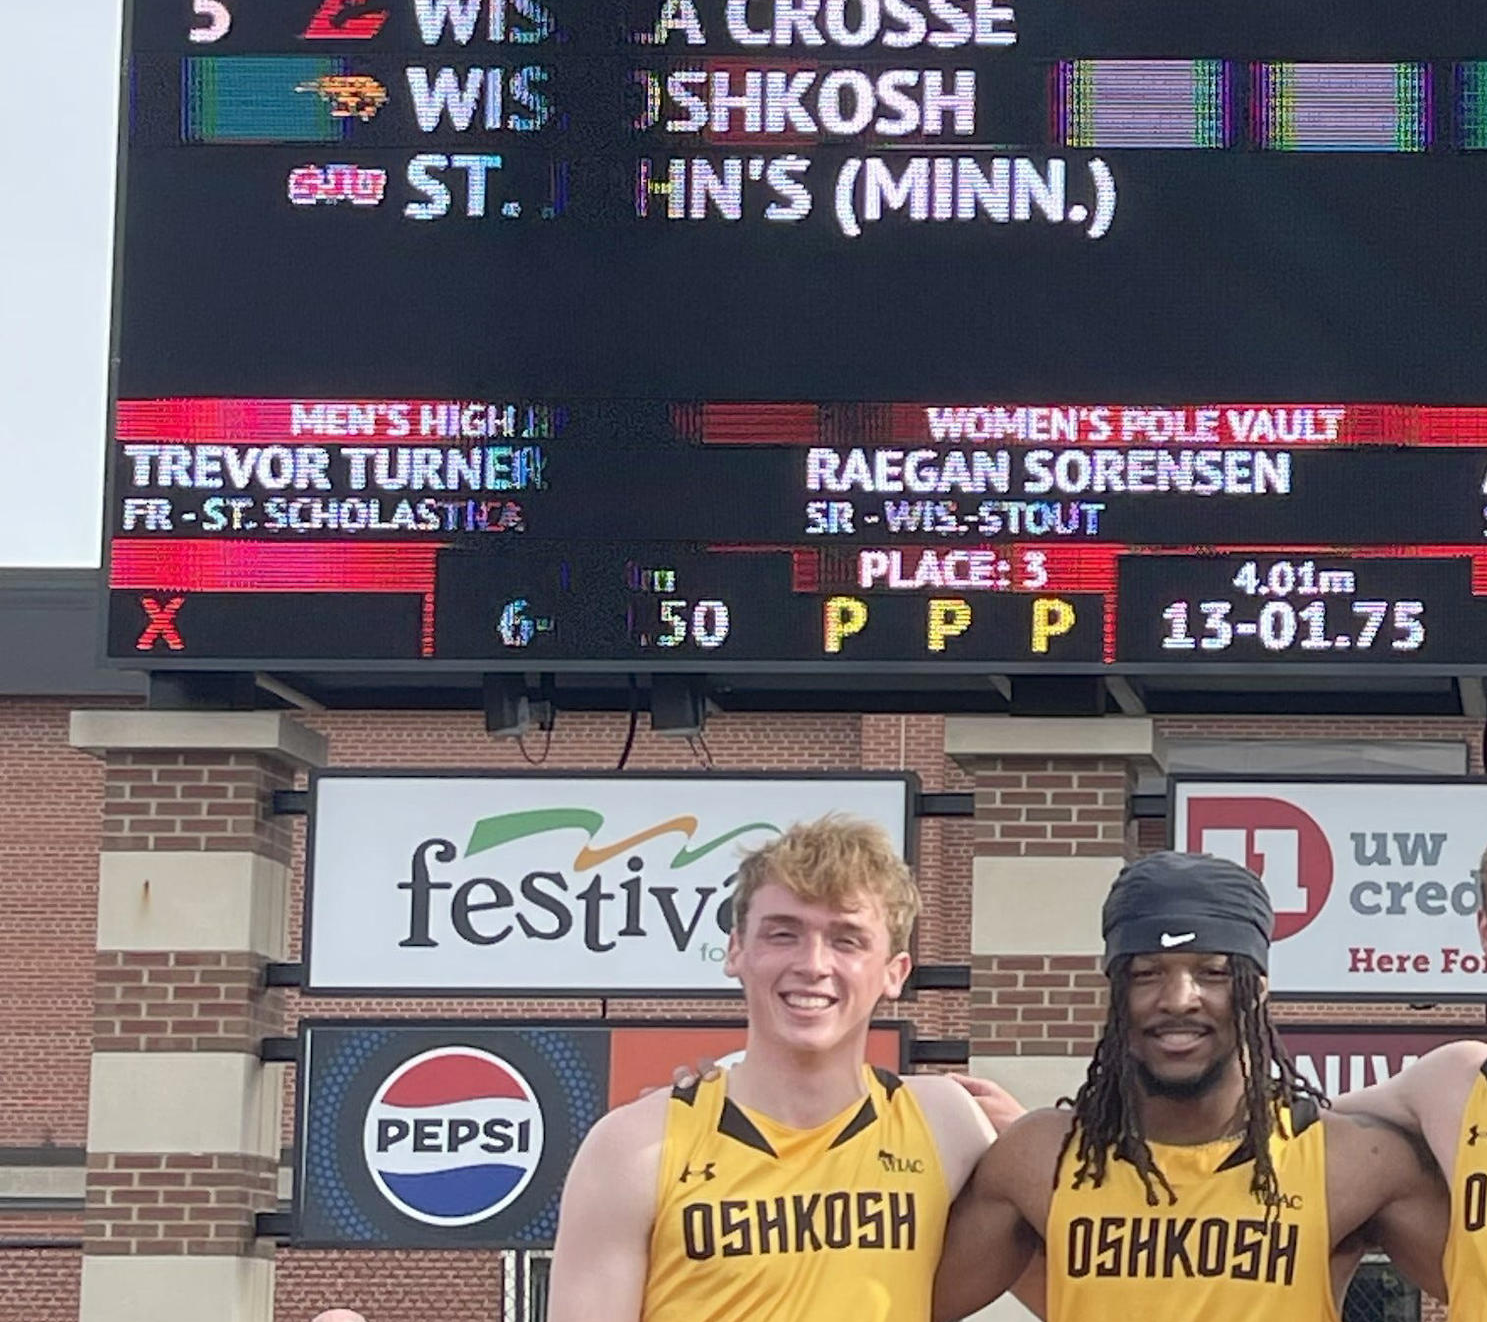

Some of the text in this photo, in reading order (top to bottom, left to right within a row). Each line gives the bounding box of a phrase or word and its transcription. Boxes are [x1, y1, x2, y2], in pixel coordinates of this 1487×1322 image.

[405, 153, 522, 220] ST.
[834, 155, 1117, 238] (MINN.)
[290, 403, 412, 437] MEN'S
[420, 403, 515, 437] HIGH
[926, 407, 1346, 443] WOMEN'S POLE VAULT
[123, 444, 332, 490] TREVOR
[806, 448, 1292, 495] RAEGAN SORENSEN
[122, 498, 171, 531] FR
[806, 501, 855, 535] SR
[860, 549, 1049, 589] PLACE: 3
[1232, 560, 1355, 596] 4.01m
[136, 596, 184, 651] X
[824, 596, 1077, 653] P P P
[1161, 599, 1425, 650] 13-01.75
[1350, 832, 1448, 866] uw
[1350, 869, 1483, 917] cred
[1348, 948, 1431, 973] Here
[376, 1116, 532, 1155] PEPSI
[683, 1191, 917, 1261] OSHKOSH
[1067, 1216, 1299, 1287] OSHKOSH
